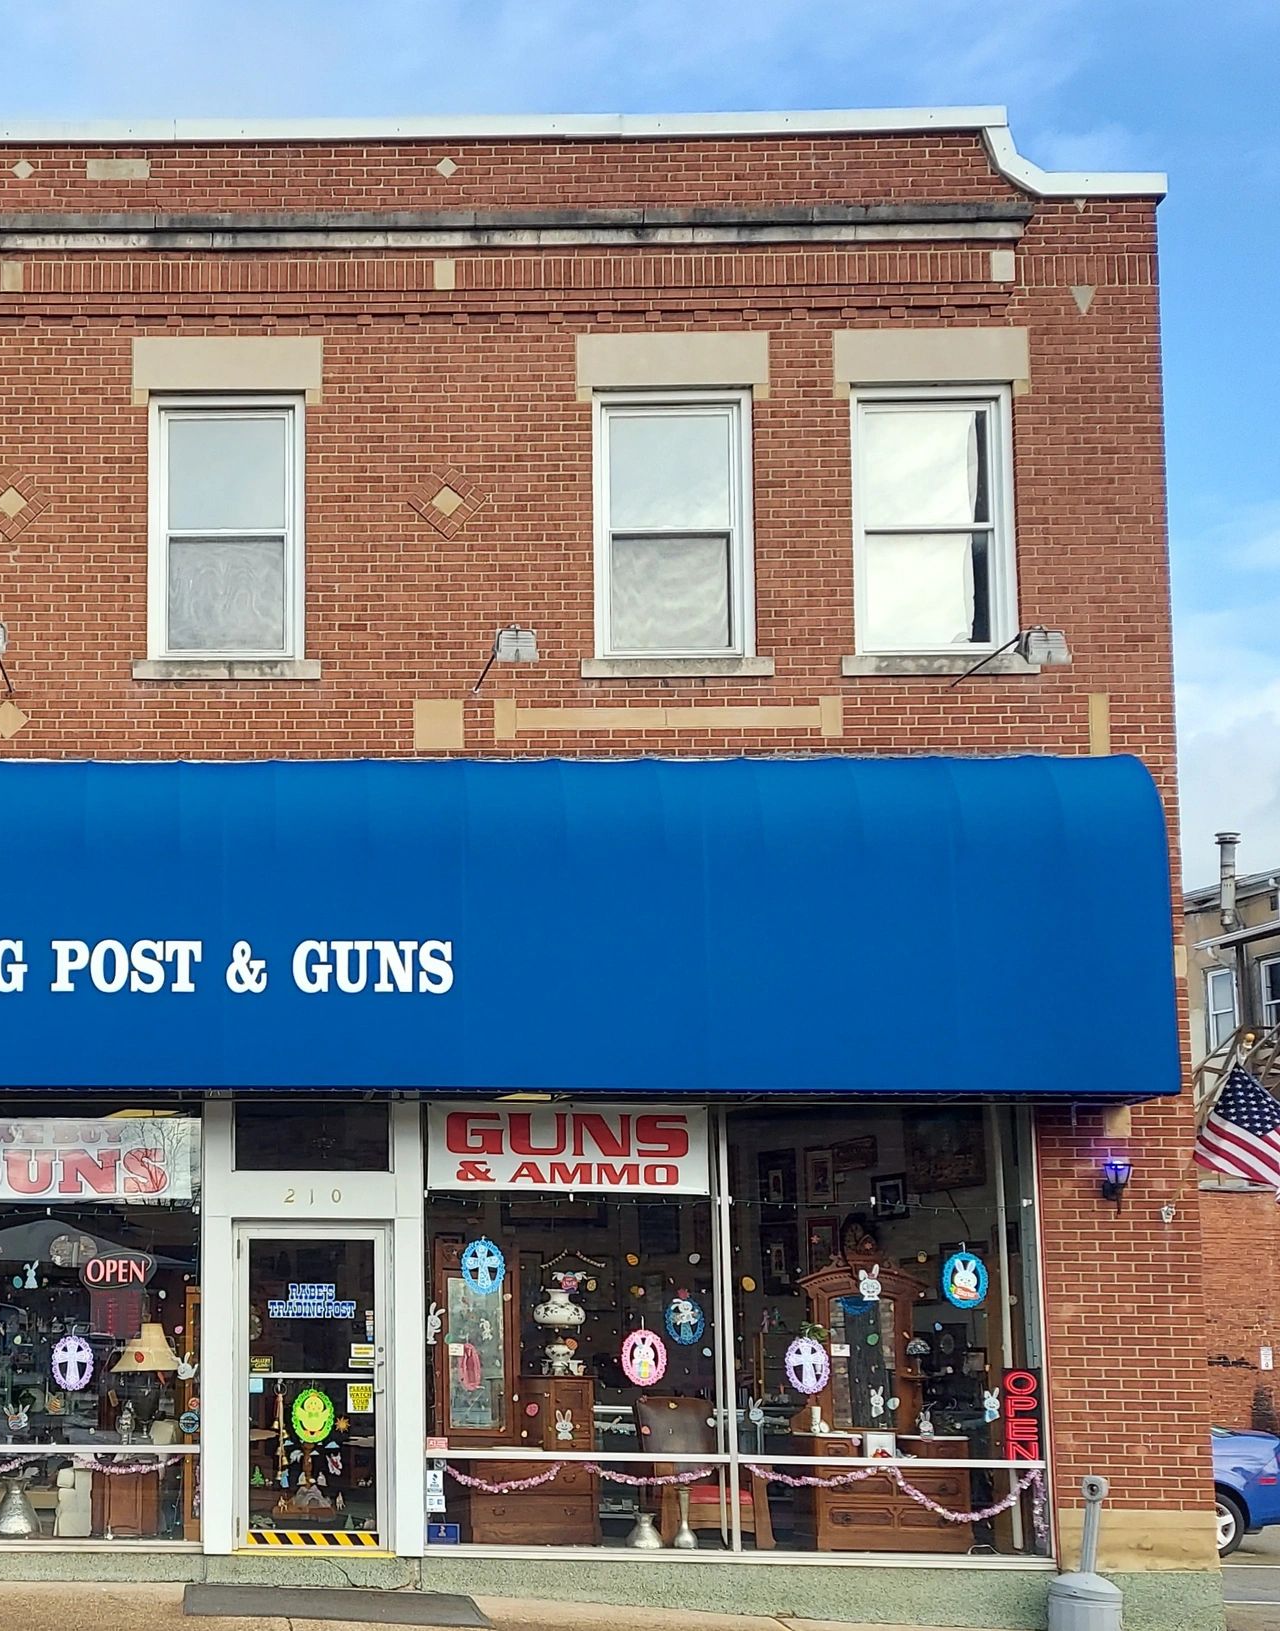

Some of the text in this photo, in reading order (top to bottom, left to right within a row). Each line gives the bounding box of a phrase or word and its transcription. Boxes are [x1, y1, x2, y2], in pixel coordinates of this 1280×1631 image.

[50, 939, 202, 994] POST
[225, 939, 268, 994] &
[291, 939, 454, 994] GUNS
[53, 1123, 122, 1144] BUY
[446, 1111, 689, 1158] GUNS
[456, 1160, 680, 1186] & AMMO
[86, 1259, 145, 1283] OPEN
[288, 1283, 336, 1300] RABE'S
[268, 1300, 356, 1318] TRADING POST
[1004, 1371, 1039, 1461] OPEN
